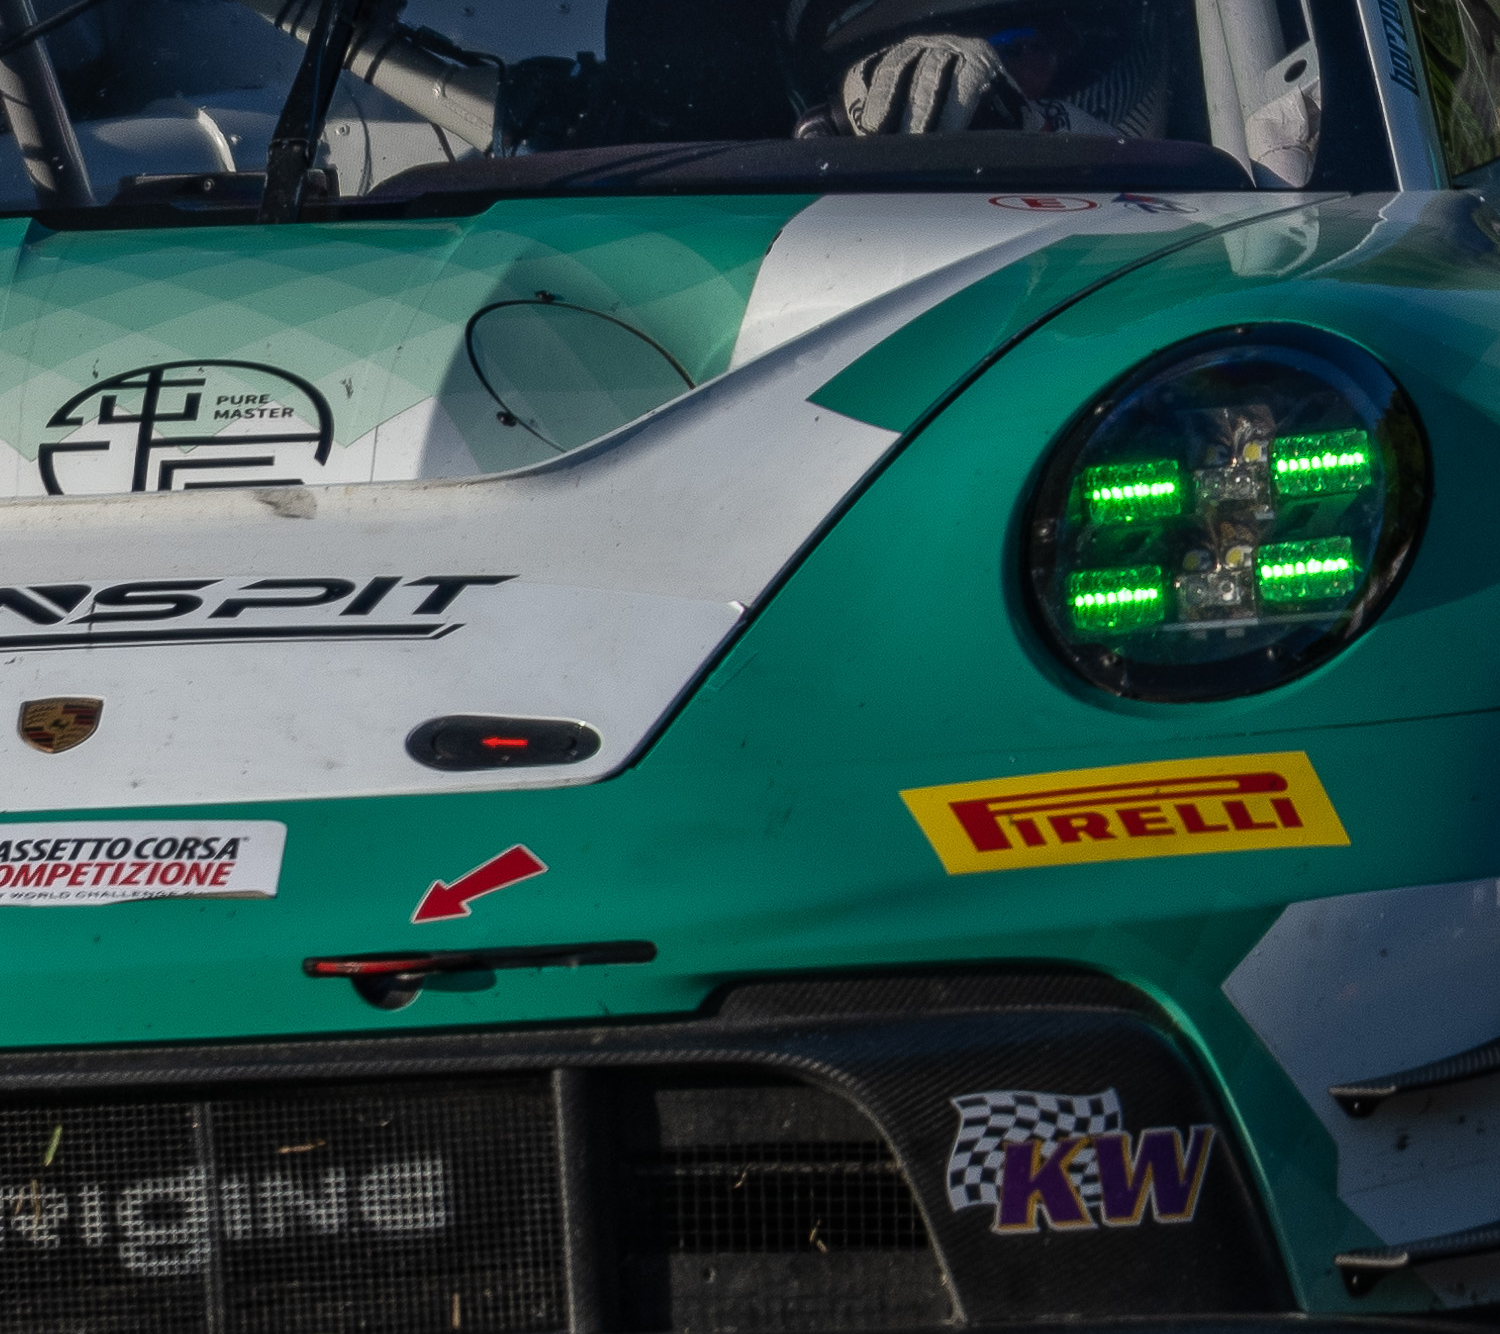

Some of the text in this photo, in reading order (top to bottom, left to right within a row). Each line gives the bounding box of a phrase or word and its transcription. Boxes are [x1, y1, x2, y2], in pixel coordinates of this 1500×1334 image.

[216, 394, 270, 405] PURE
[213, 407, 294, 420] MASTER
[948, 772, 1304, 852] PIRELLI
[134, 837, 240, 861] CORSA
[990, 1123, 1218, 1235] KW
